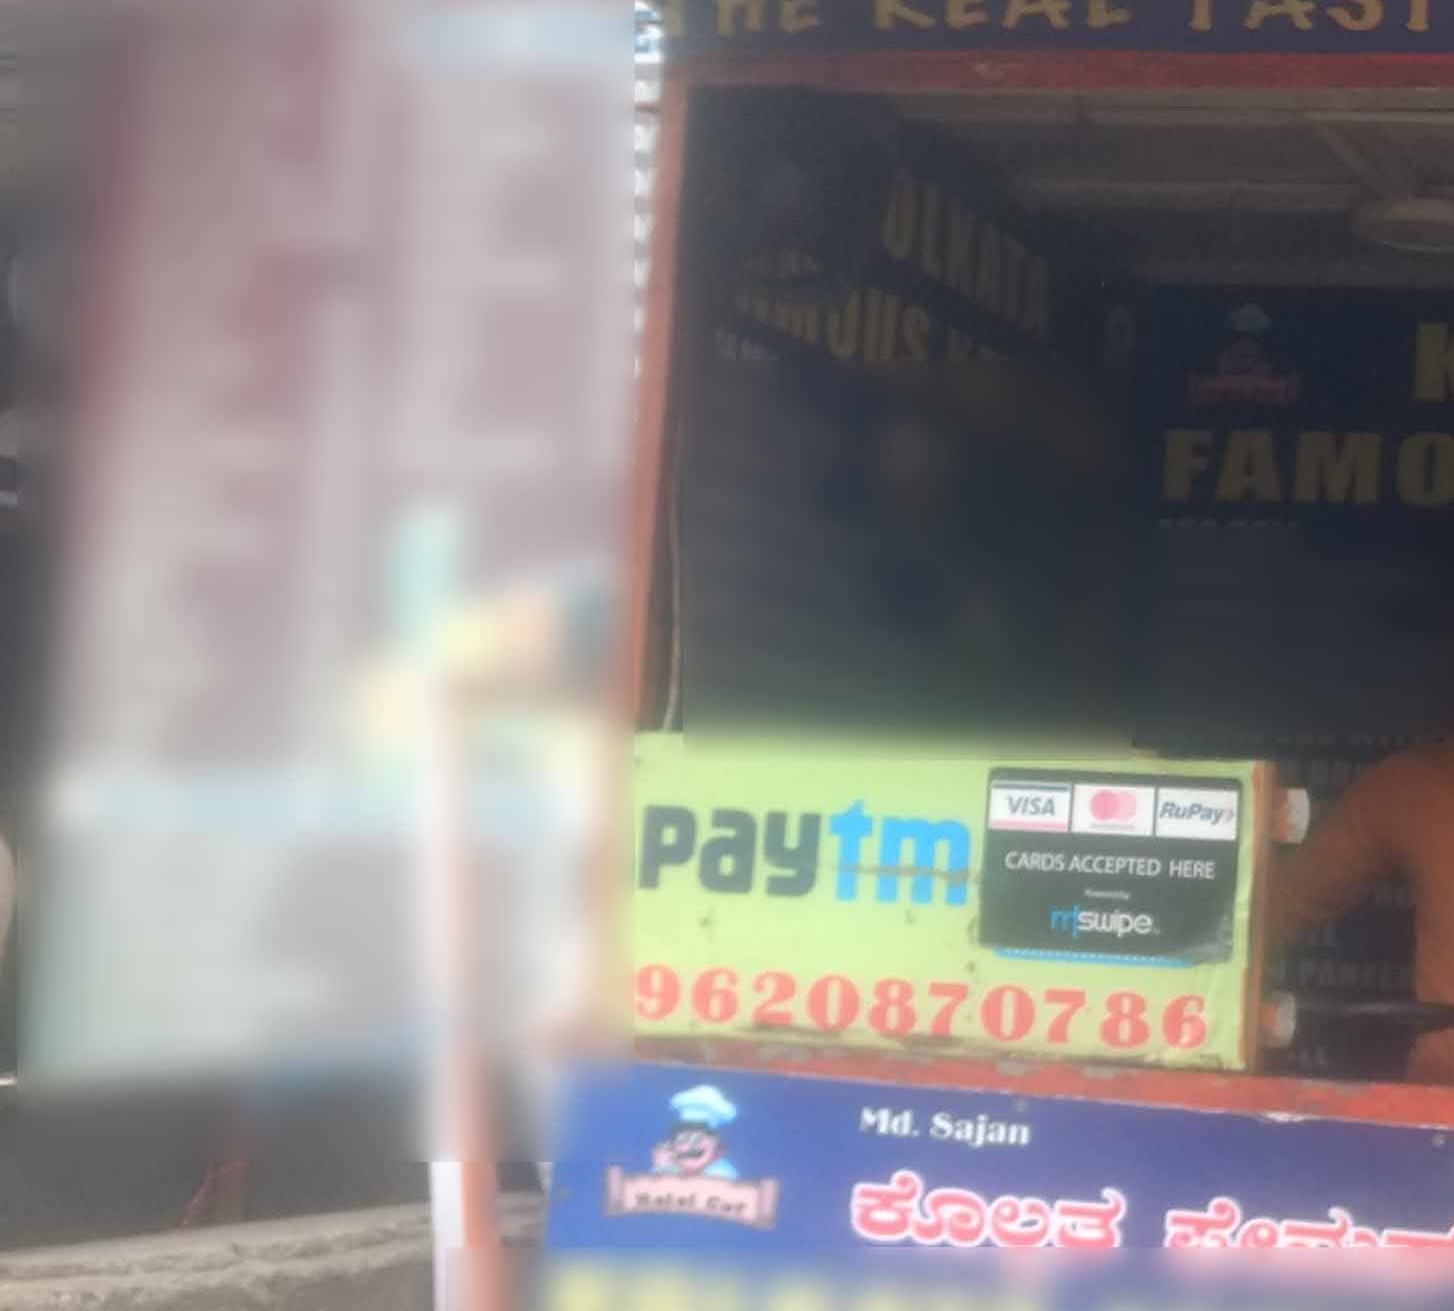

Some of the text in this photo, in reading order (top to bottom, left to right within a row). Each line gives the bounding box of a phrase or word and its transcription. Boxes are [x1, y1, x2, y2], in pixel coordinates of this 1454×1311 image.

[1006, 795, 1224, 826] VISA RuPay
[1004, 851, 1216, 880] CARDS ACCEPTED HERE
[634, 963, 1209, 1050] 9620870786
[859, 1106, 1031, 1149] Md. Sajan
